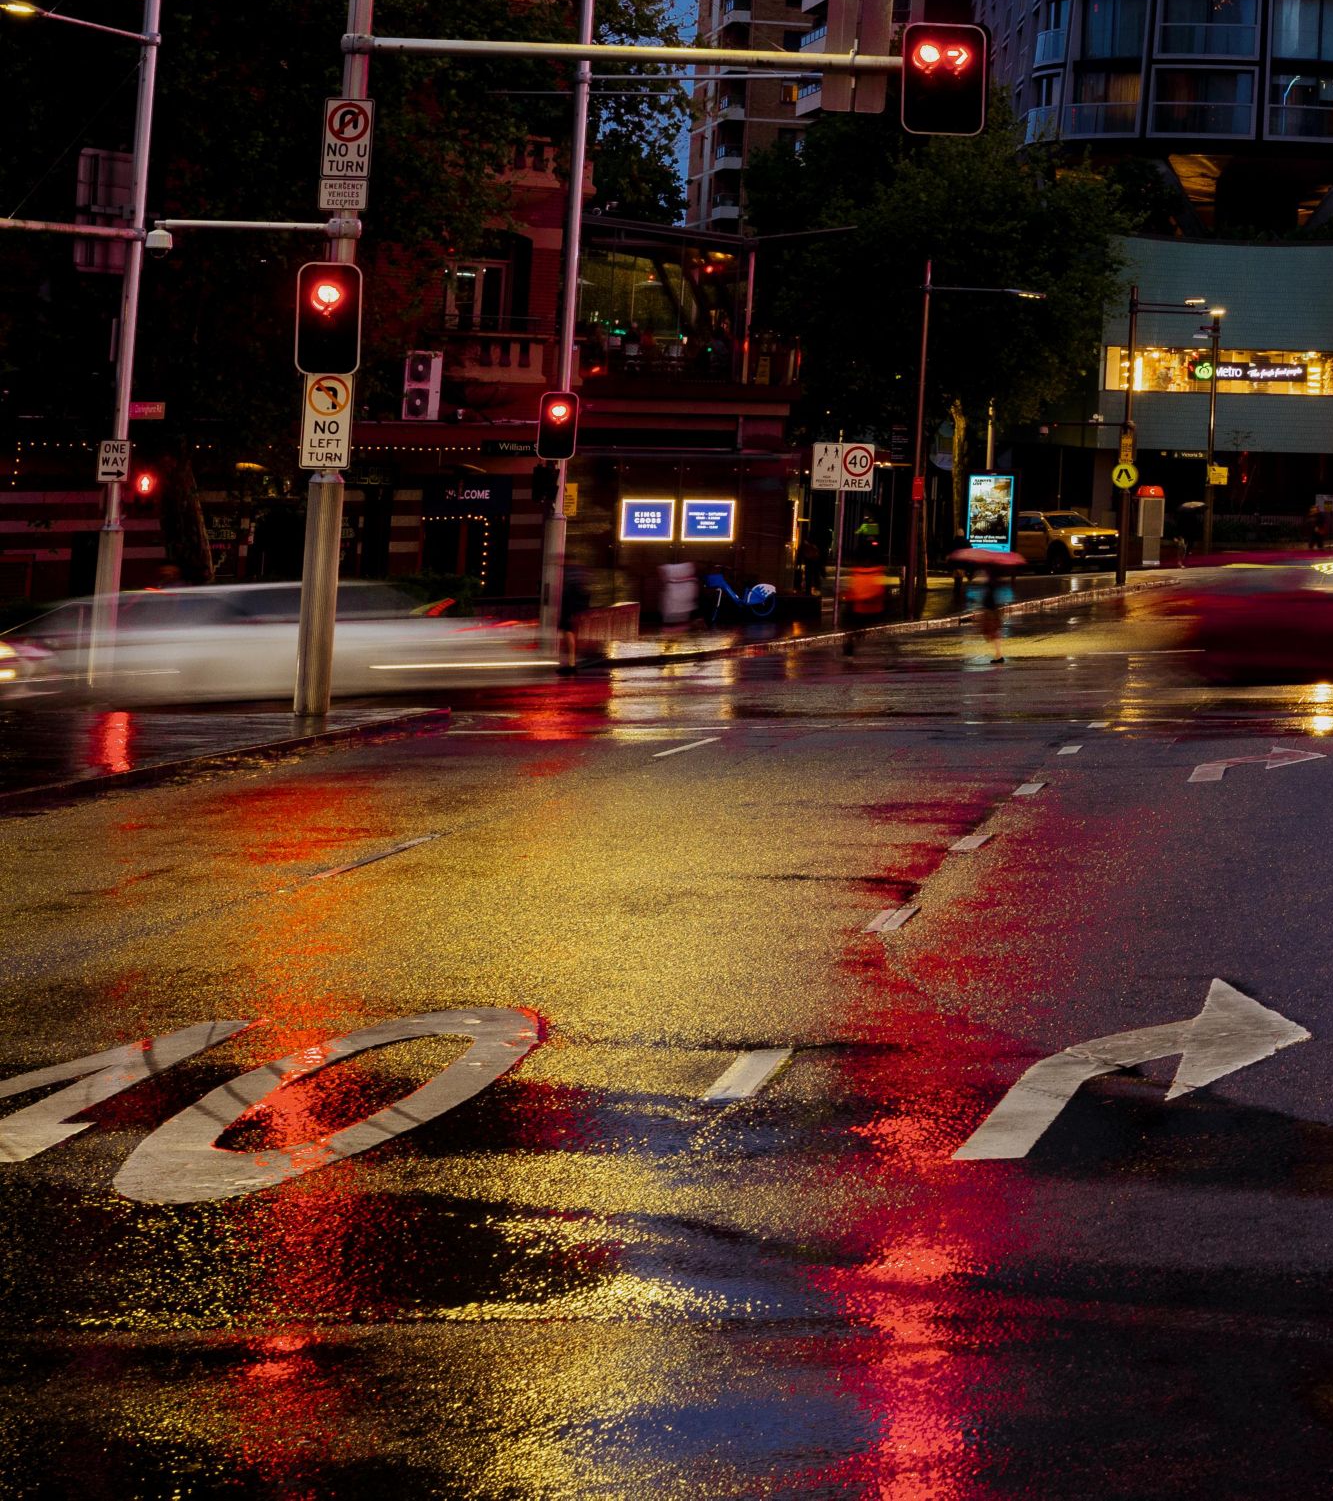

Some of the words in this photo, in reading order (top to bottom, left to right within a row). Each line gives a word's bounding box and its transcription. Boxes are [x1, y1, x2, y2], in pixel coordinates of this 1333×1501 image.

[326, 143, 348, 157] NO
[357, 144, 367, 158] U
[328, 160, 364, 172] TURN
[324, 182, 363, 190] EMERGENCY
[314, 421, 339, 435] NO
[104, 443, 126, 453] ONE
[310, 439, 341, 448] LEFT
[499, 442, 531, 451] William
[102, 457, 126, 467] WAY
[308, 452, 342, 462] TURN
[849, 455, 869, 468] 40
[843, 479, 870, 488] AREA
